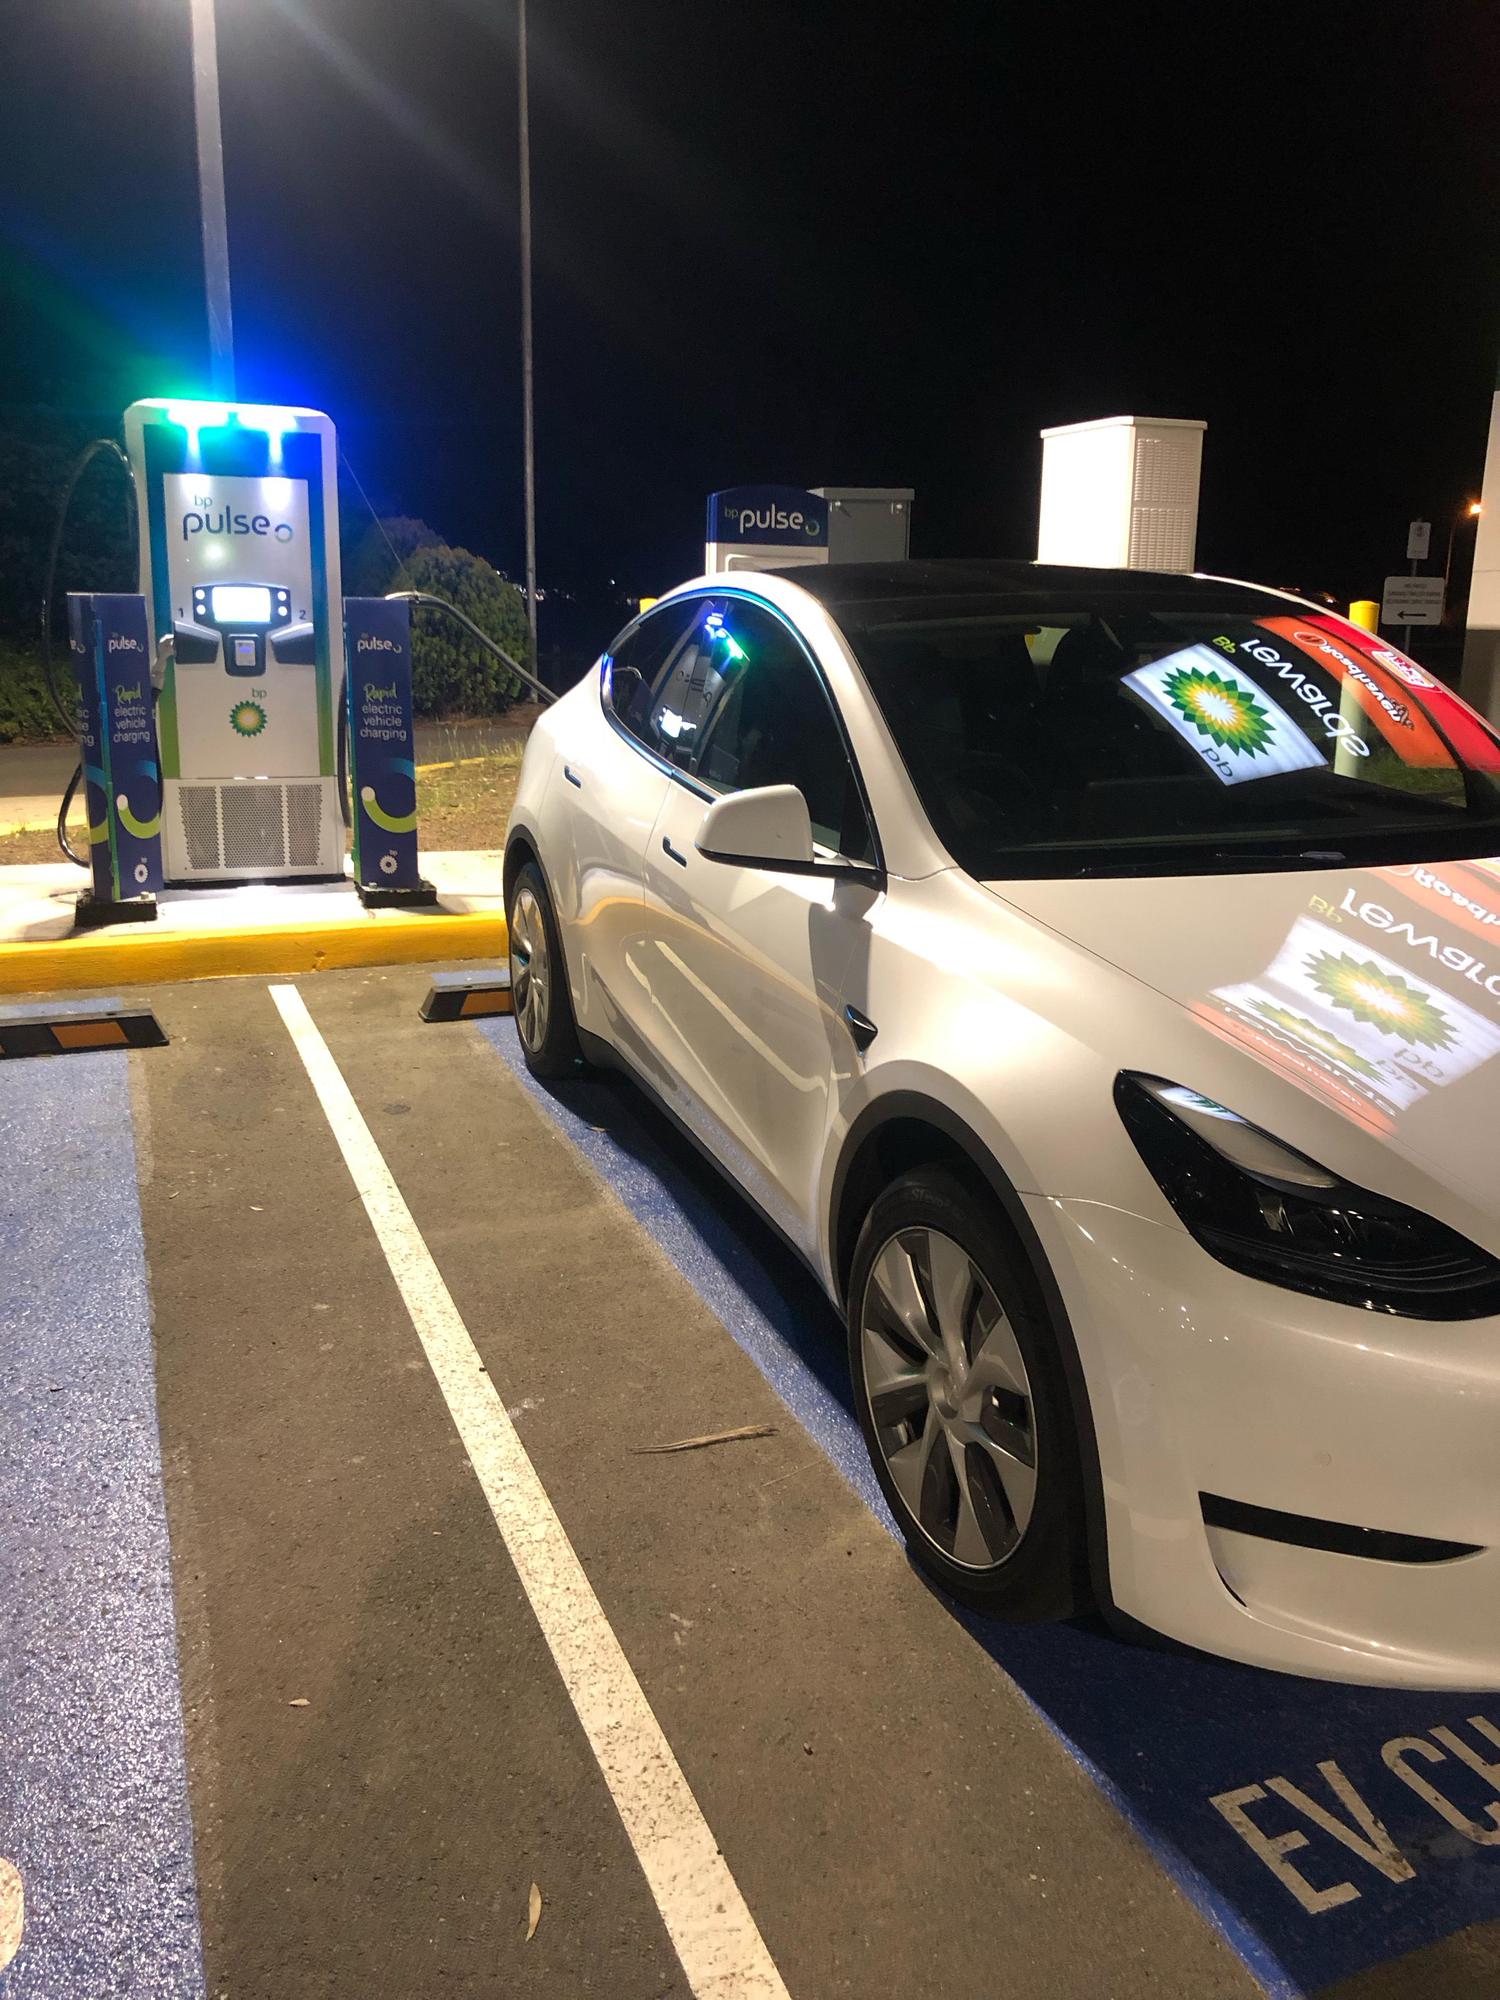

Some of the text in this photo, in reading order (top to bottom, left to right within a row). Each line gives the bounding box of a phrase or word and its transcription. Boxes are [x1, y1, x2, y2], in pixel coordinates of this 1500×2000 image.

[194, 496, 213, 509] bp
[183, 505, 270, 541] pulse
[724, 503, 804, 534] bp pulse
[178, 607, 184, 618] 1
[299, 610, 306, 620] 2
[109, 636, 137, 653] pulse
[357, 636, 392, 653] pulse
[251, 688, 267, 699] bp
[363, 682, 397, 702] Rapid
[114, 705, 147, 716] electric
[362, 703, 403, 715] electric
[116, 717, 146, 729] vehicle
[363, 716, 402, 727] vehicle
[113, 730, 151, 744] charging
[360, 728, 407, 741] charging
[1209, 1760, 1417, 1914] EV
